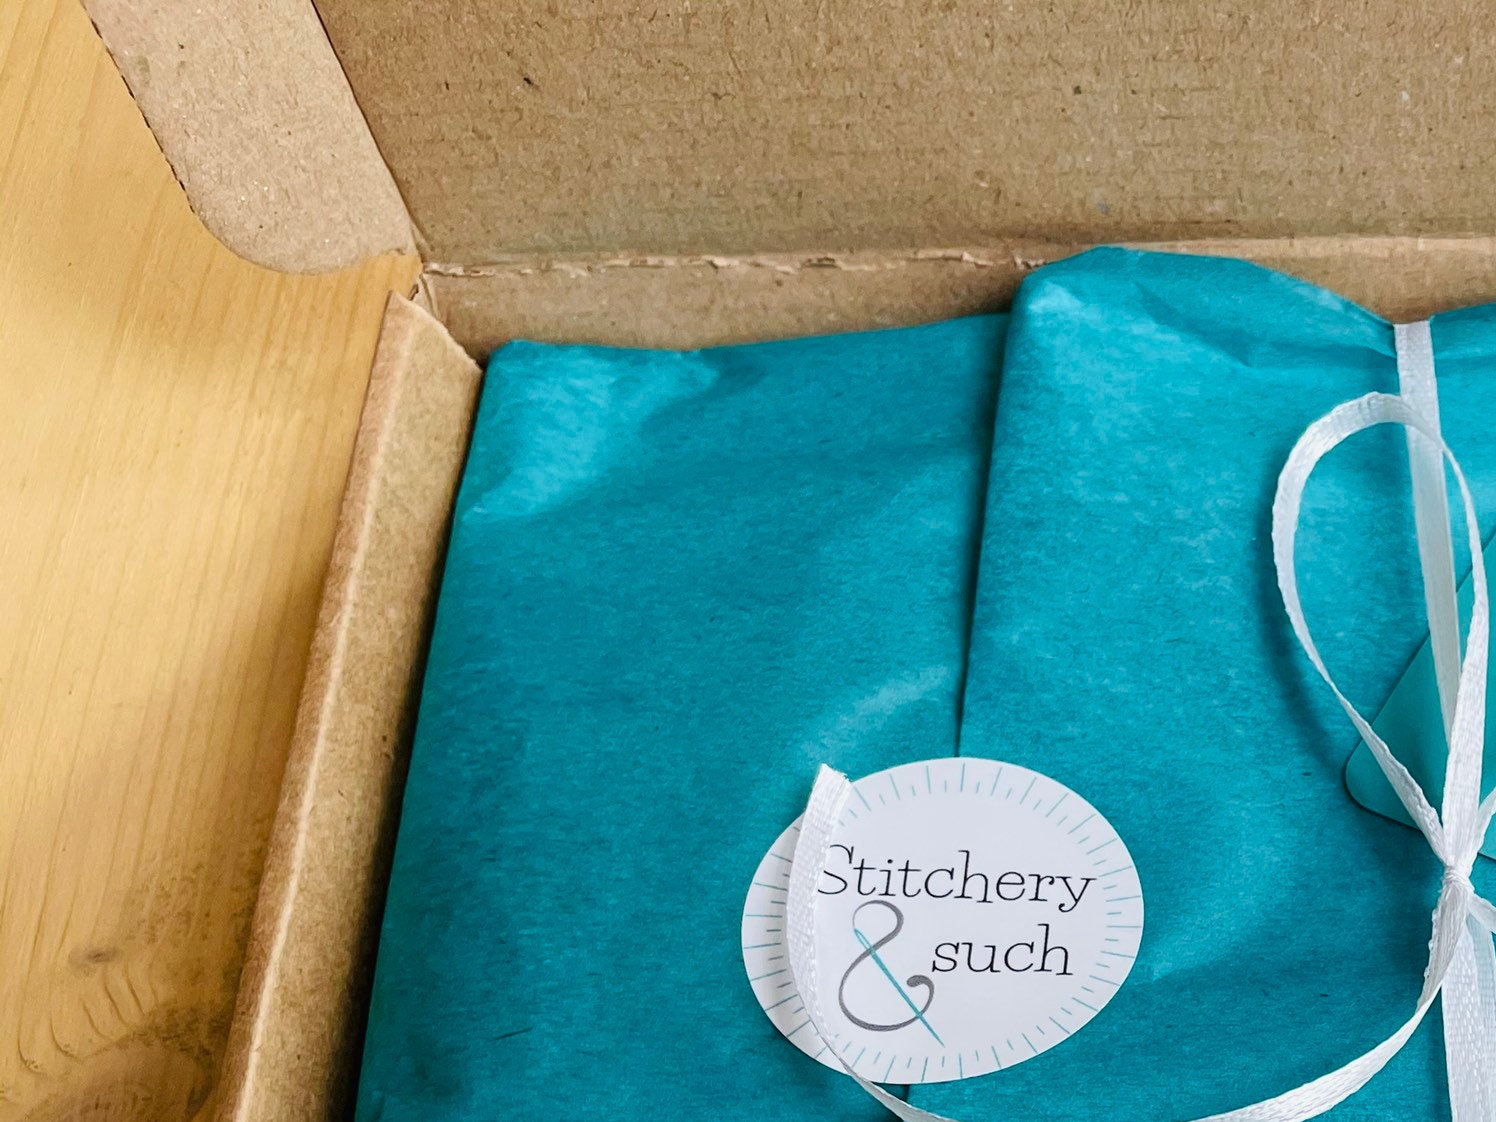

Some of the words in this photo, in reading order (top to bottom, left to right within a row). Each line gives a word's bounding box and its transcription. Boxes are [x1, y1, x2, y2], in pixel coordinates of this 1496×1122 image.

[817, 843, 1098, 913] Stitchery
[838, 900, 946, 1049] &
[931, 924, 1074, 976] such
